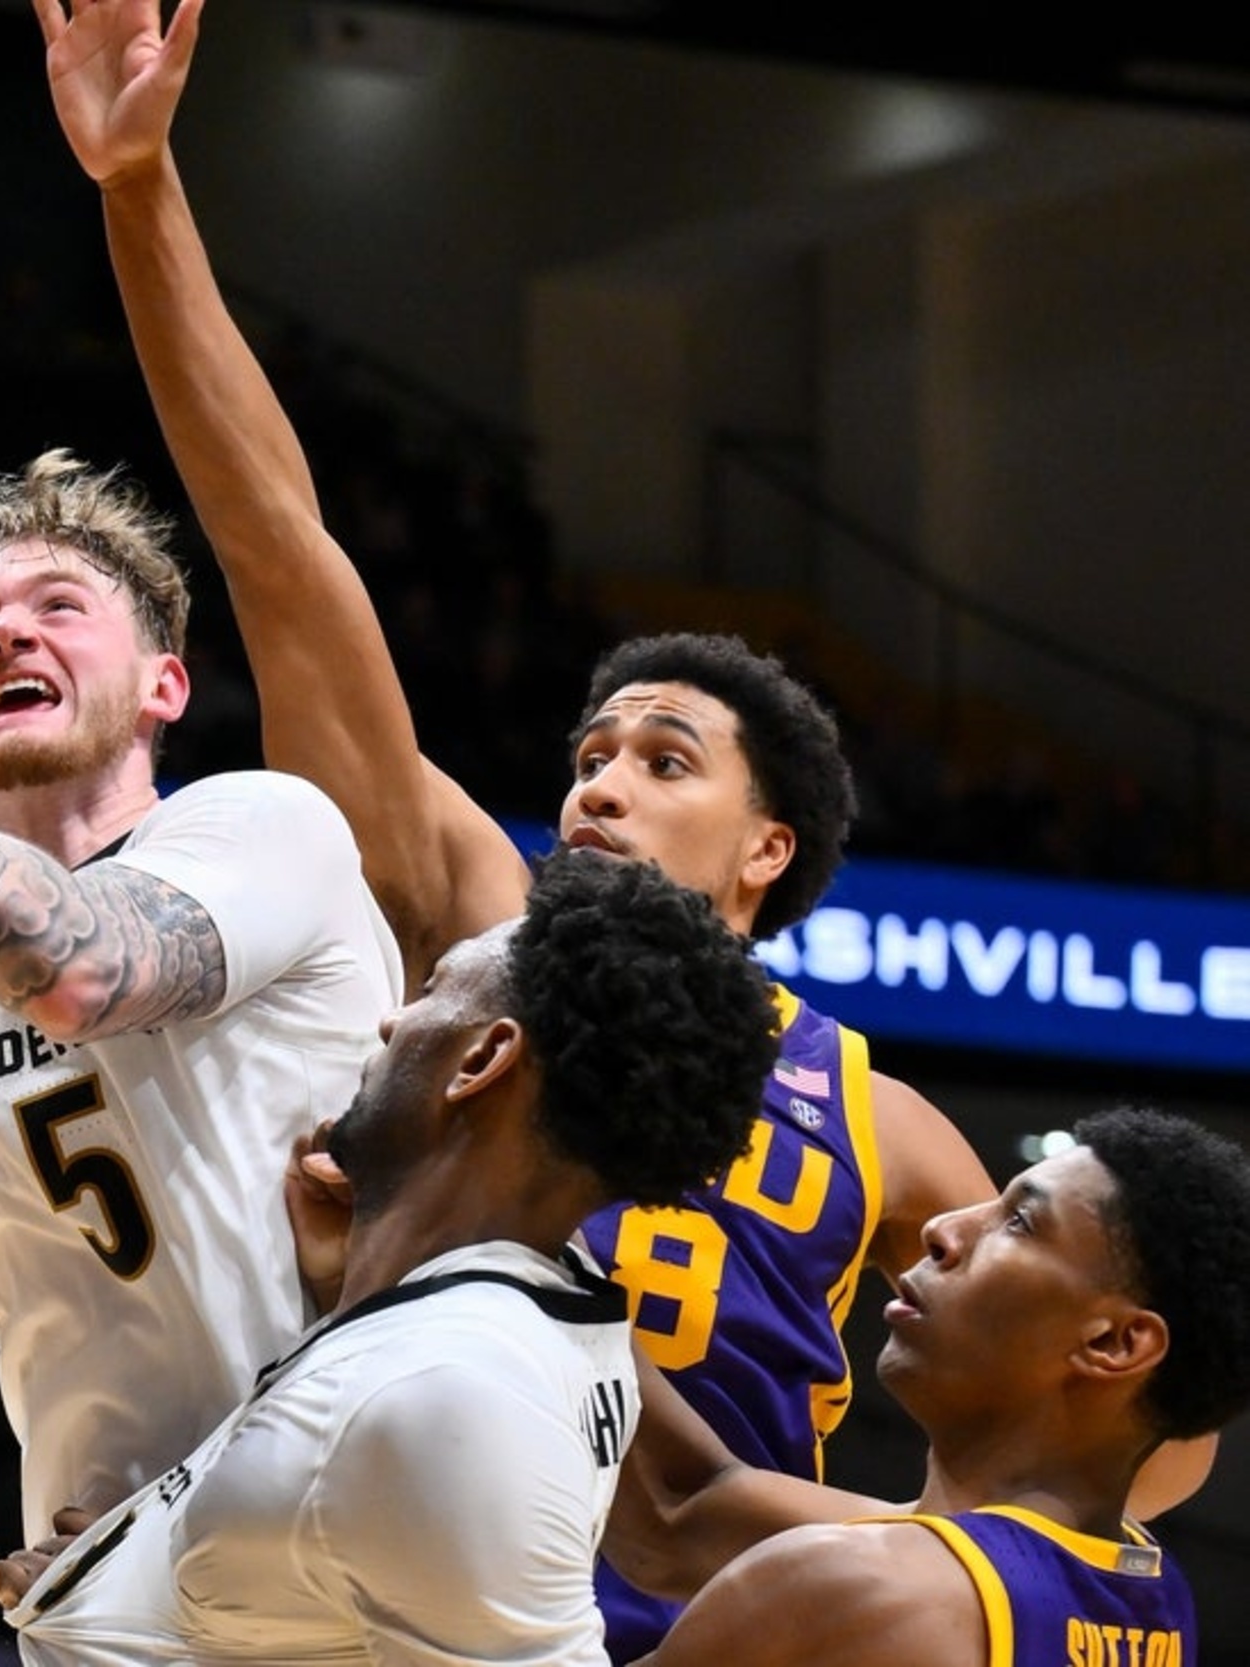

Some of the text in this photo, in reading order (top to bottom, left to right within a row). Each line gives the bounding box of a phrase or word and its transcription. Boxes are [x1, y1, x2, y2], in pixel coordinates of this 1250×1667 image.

[748, 907, 1250, 1021] SHVILLE
[12, 1072, 156, 1283] 5
[610, 1204, 729, 1372] 8
